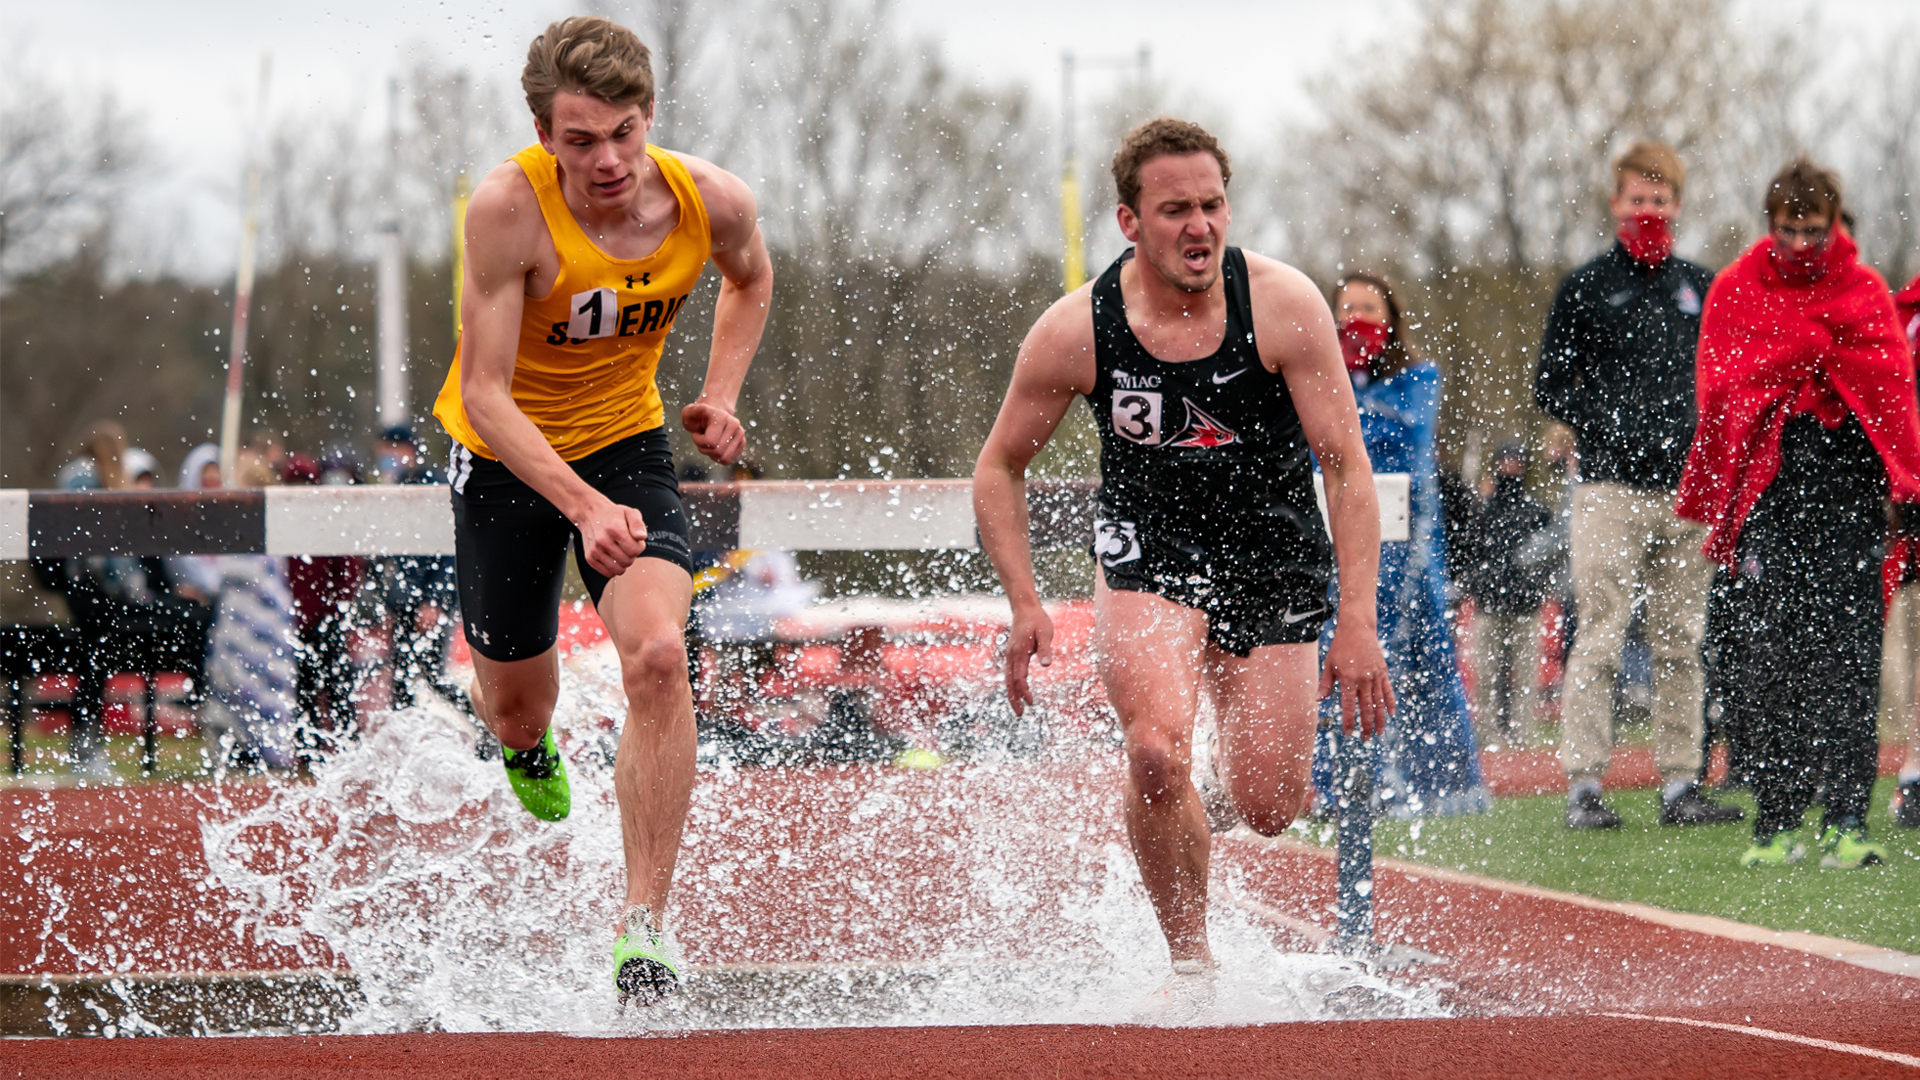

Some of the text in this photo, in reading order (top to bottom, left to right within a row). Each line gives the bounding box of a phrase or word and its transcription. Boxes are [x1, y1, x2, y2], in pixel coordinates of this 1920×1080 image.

[546, 293, 688, 345] SERI
[578, 291, 602, 336] 1
[1118, 395, 1153, 440] 3
[1099, 522, 1132, 562] 3
